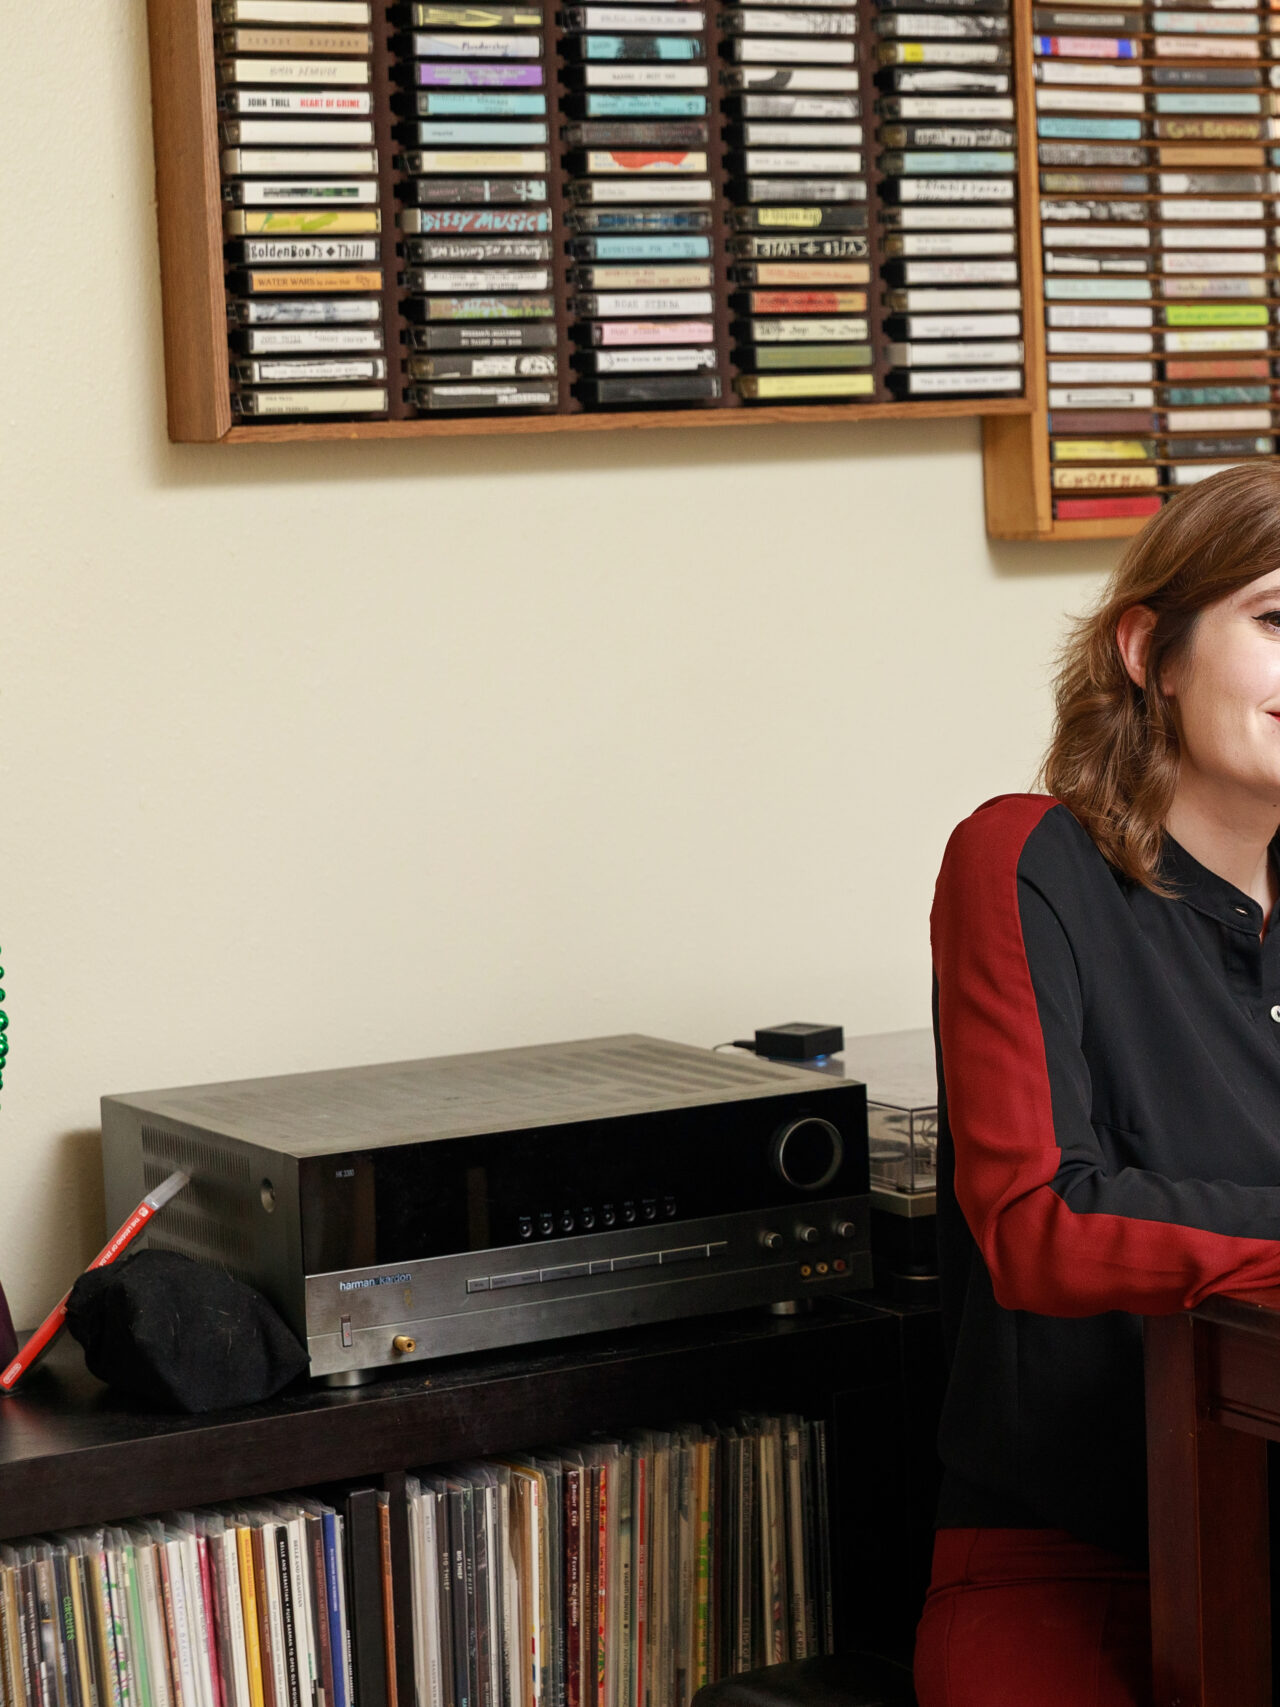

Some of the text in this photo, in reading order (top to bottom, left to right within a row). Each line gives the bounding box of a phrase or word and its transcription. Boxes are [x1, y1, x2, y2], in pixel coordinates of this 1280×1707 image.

[248, 98, 360, 108] JOHN THILL HEART OF GRIME
[257, 278, 288, 287] WATER
[290, 277, 315, 286] WARS
[132, 1217, 141, 1228] THE
[116, 1225, 133, 1245] LEGEND
[111, 1244, 118, 1252] OF
[570, 1510, 578, 1527] EYES
[442, 1552, 450, 1566] BIG
[295, 1574, 304, 1608] SEBASTIAN
[570, 1582, 578, 1596] AND
[282, 1572, 290, 1602] SEBASTIAN
[286, 1623, 294, 1646] BARMAN
[570, 1598, 578, 1628] MIRRORS
